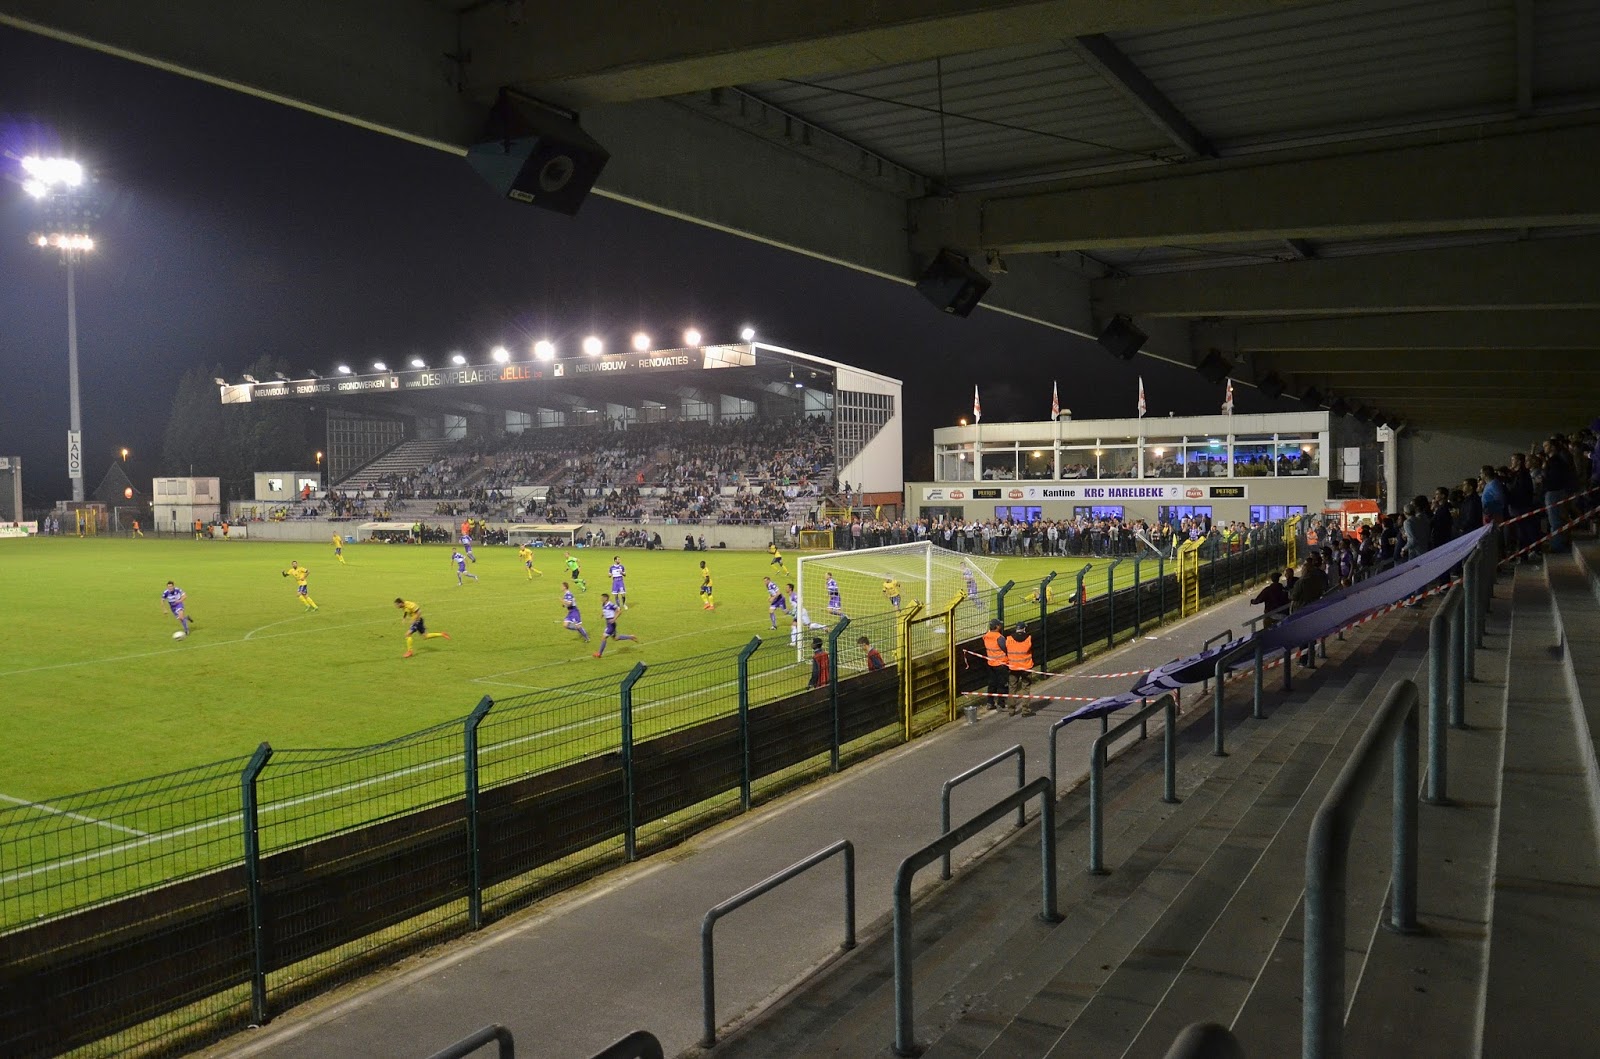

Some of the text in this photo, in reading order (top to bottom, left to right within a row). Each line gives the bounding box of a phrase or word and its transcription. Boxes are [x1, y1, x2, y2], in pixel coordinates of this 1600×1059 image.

[575, 355, 689, 372] NIEUWBOUW RENOVATIES
[254, 379, 385, 397] NIEUWBOUW RENOVATIES GRONDWERKEN
[70, 435, 80, 469] LANO
[1043, 487, 1164, 498] Kantine KRC HARELBEKE
